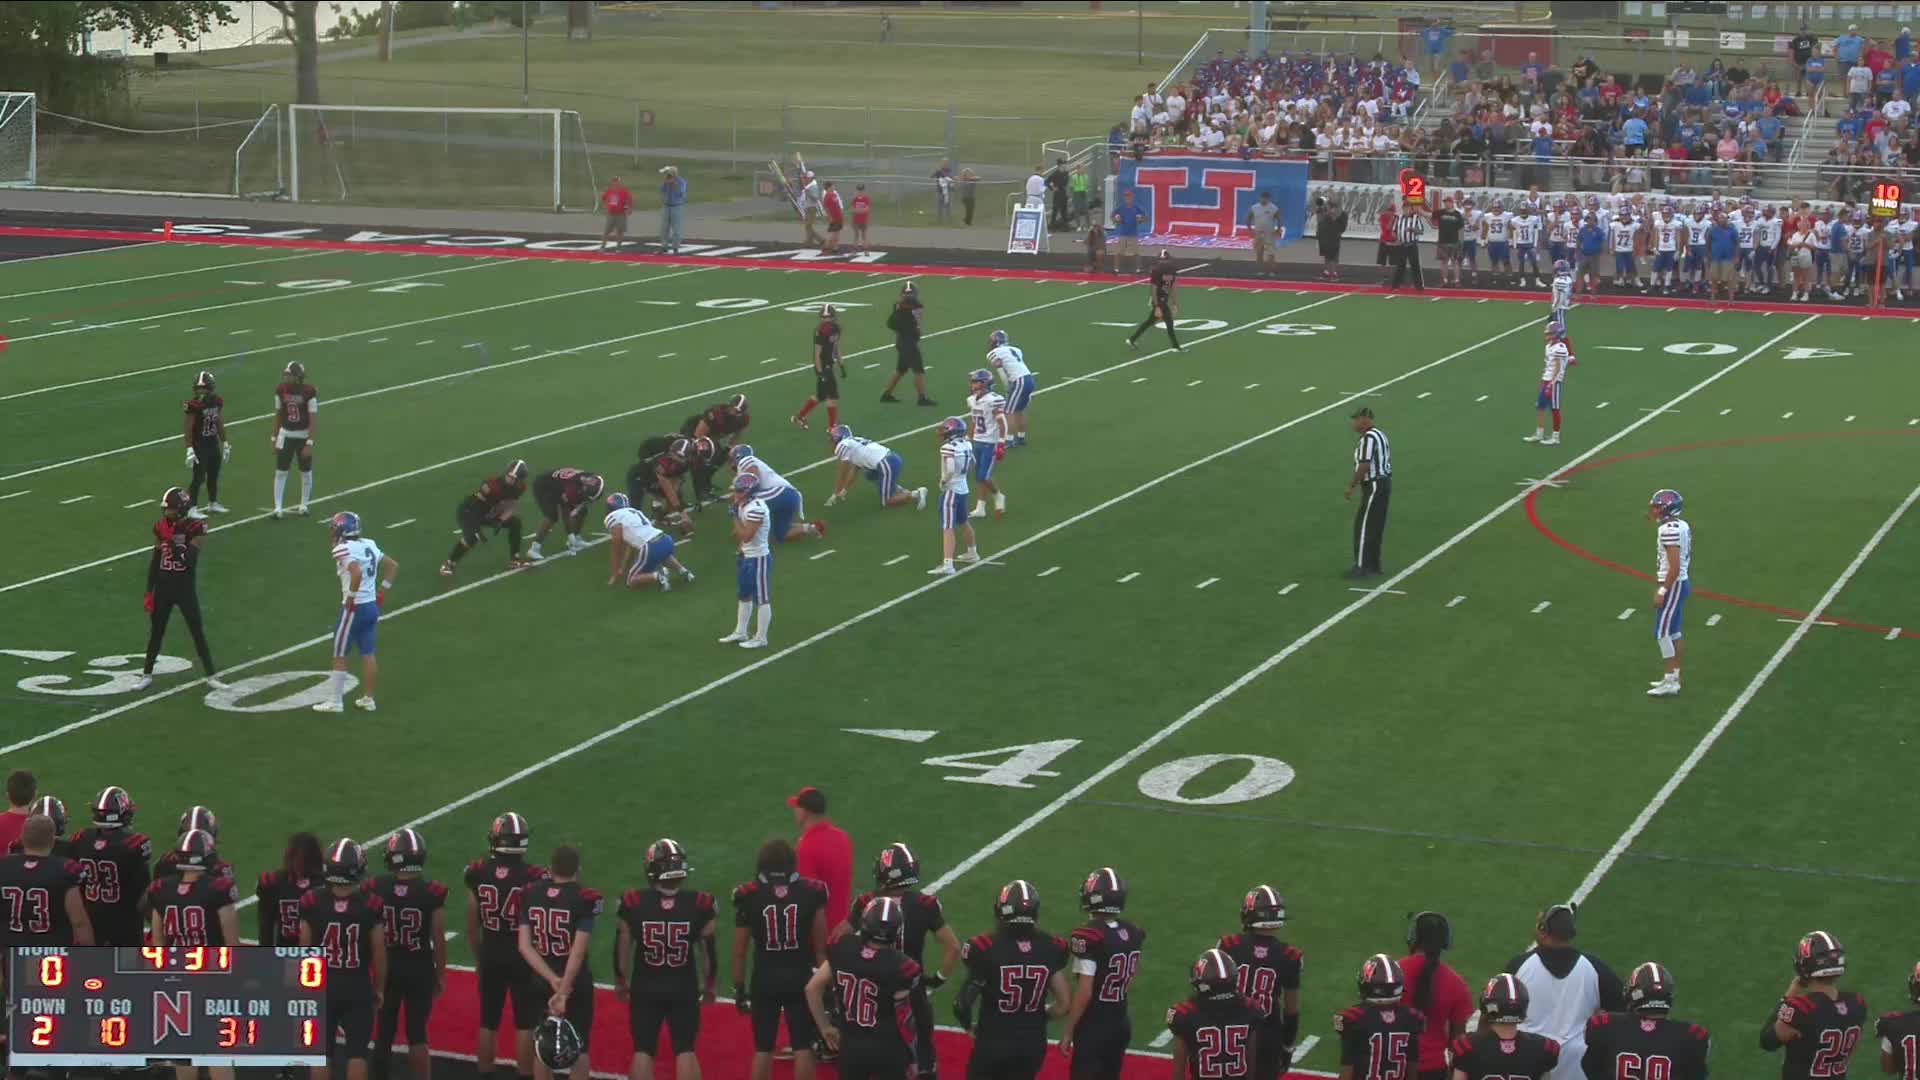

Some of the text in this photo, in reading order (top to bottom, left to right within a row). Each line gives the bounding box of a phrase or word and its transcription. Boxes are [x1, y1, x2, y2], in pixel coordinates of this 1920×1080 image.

[1408, 179, 1423, 195] 2
[1877, 184, 1900, 200] 10
[364, 547, 377, 577] 3
[1, 887, 51, 933] 73
[162, 905, 208, 946] 48
[478, 884, 521, 931] 24
[528, 906, 571, 956] 35
[762, 903, 799, 951] 11
[321, 922, 361, 968] 41
[641, 921, 690, 967] 55
[836, 969, 878, 1028] 76
[998, 964, 1049, 1013] 57
[1236, 963, 1277, 1017] 18
[1196, 1024, 1249, 1078] 25
[1365, 1032, 1411, 1080] 15
[1810, 1025, 1861, 1077] 29
